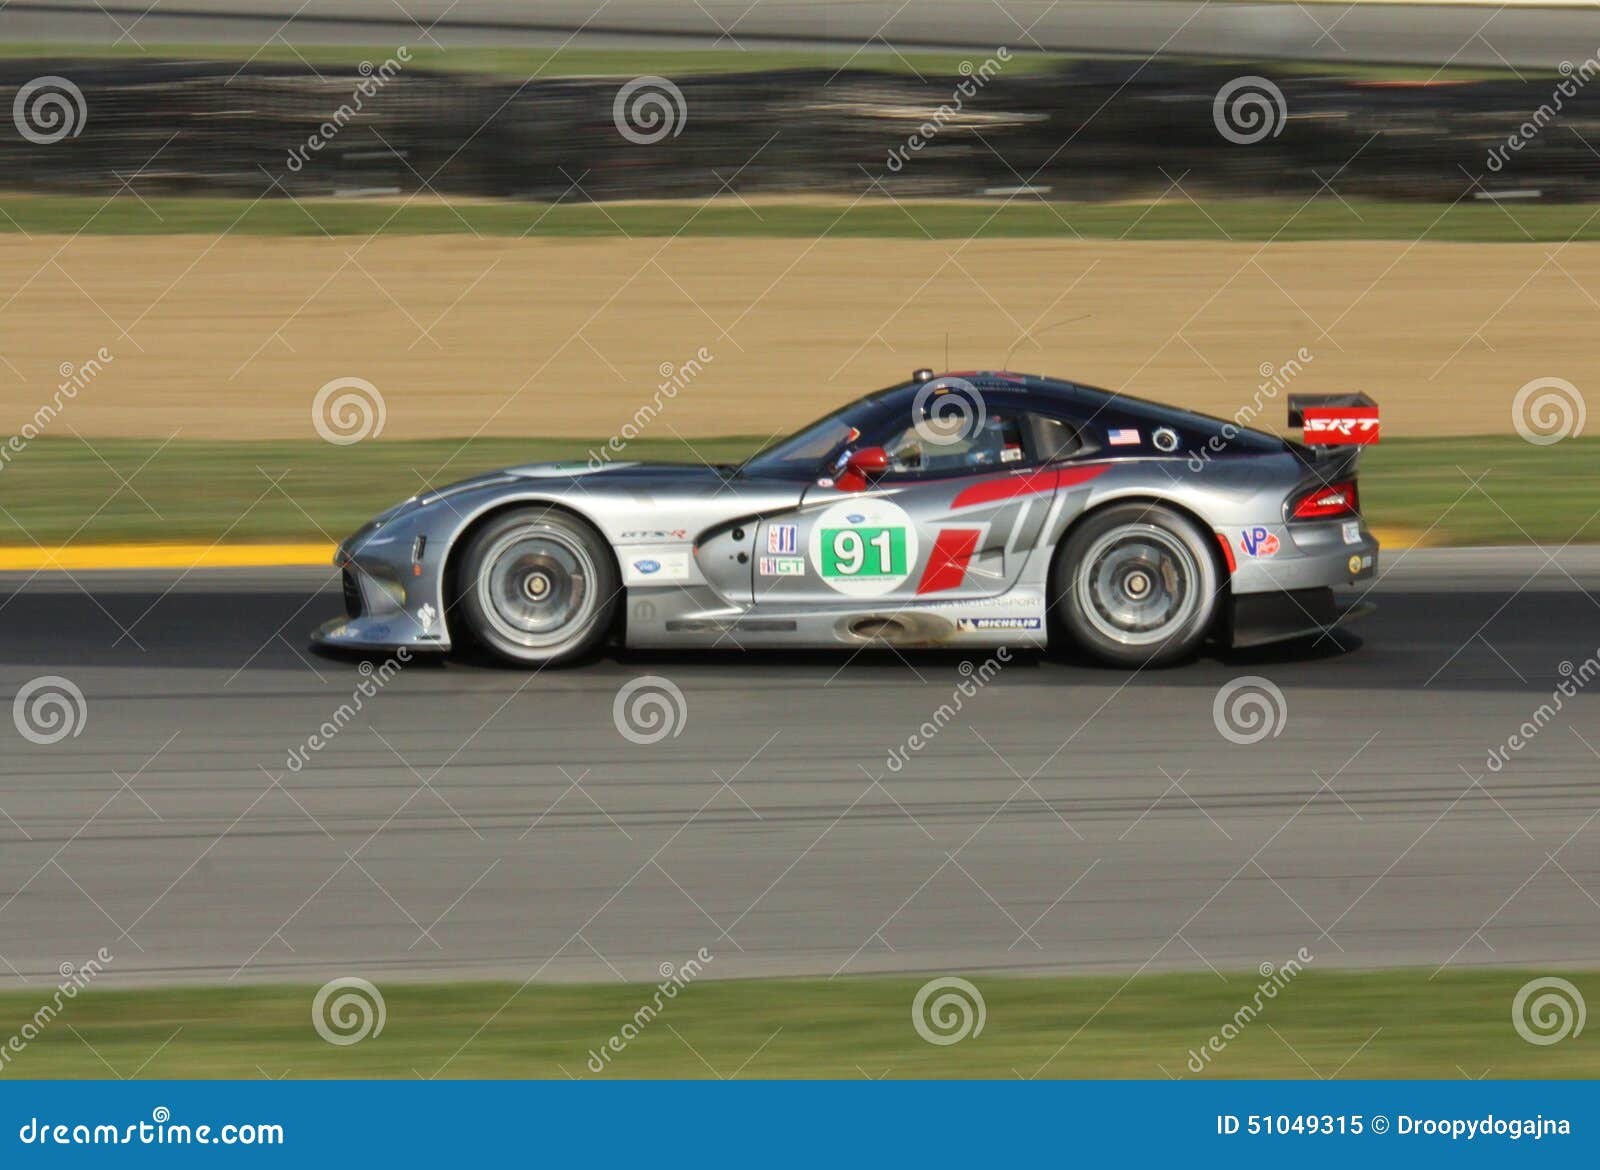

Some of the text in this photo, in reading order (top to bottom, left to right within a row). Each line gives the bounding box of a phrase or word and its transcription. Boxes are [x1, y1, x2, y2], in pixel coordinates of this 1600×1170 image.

[1303, 418, 1379, 435] SRT
[1242, 527, 1267, 556] VP
[833, 529, 893, 575] 91
[778, 559, 804, 573] GT
[977, 618, 1038, 629] MICHELIN
